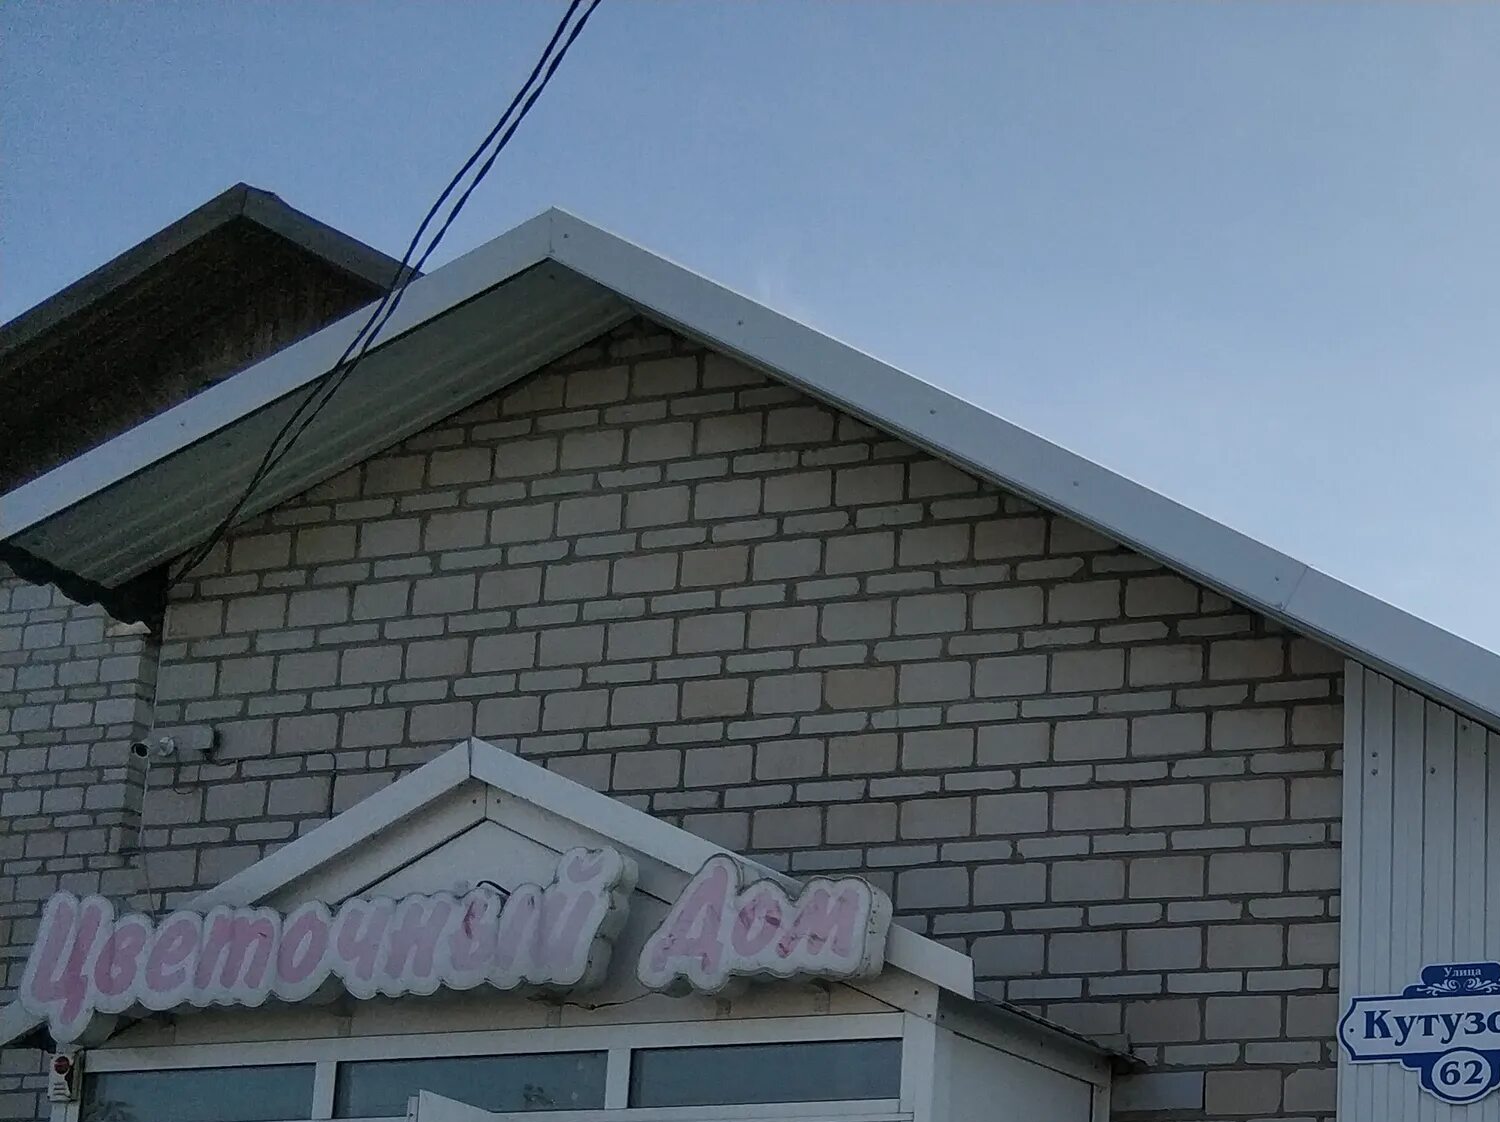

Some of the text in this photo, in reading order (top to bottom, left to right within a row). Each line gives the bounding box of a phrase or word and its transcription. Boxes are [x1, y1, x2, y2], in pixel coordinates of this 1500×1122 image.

[30, 849, 868, 1028] Цветочный Дом
[1443, 966, 1483, 979] Улица
[1438, 1059, 1485, 1086] 62
